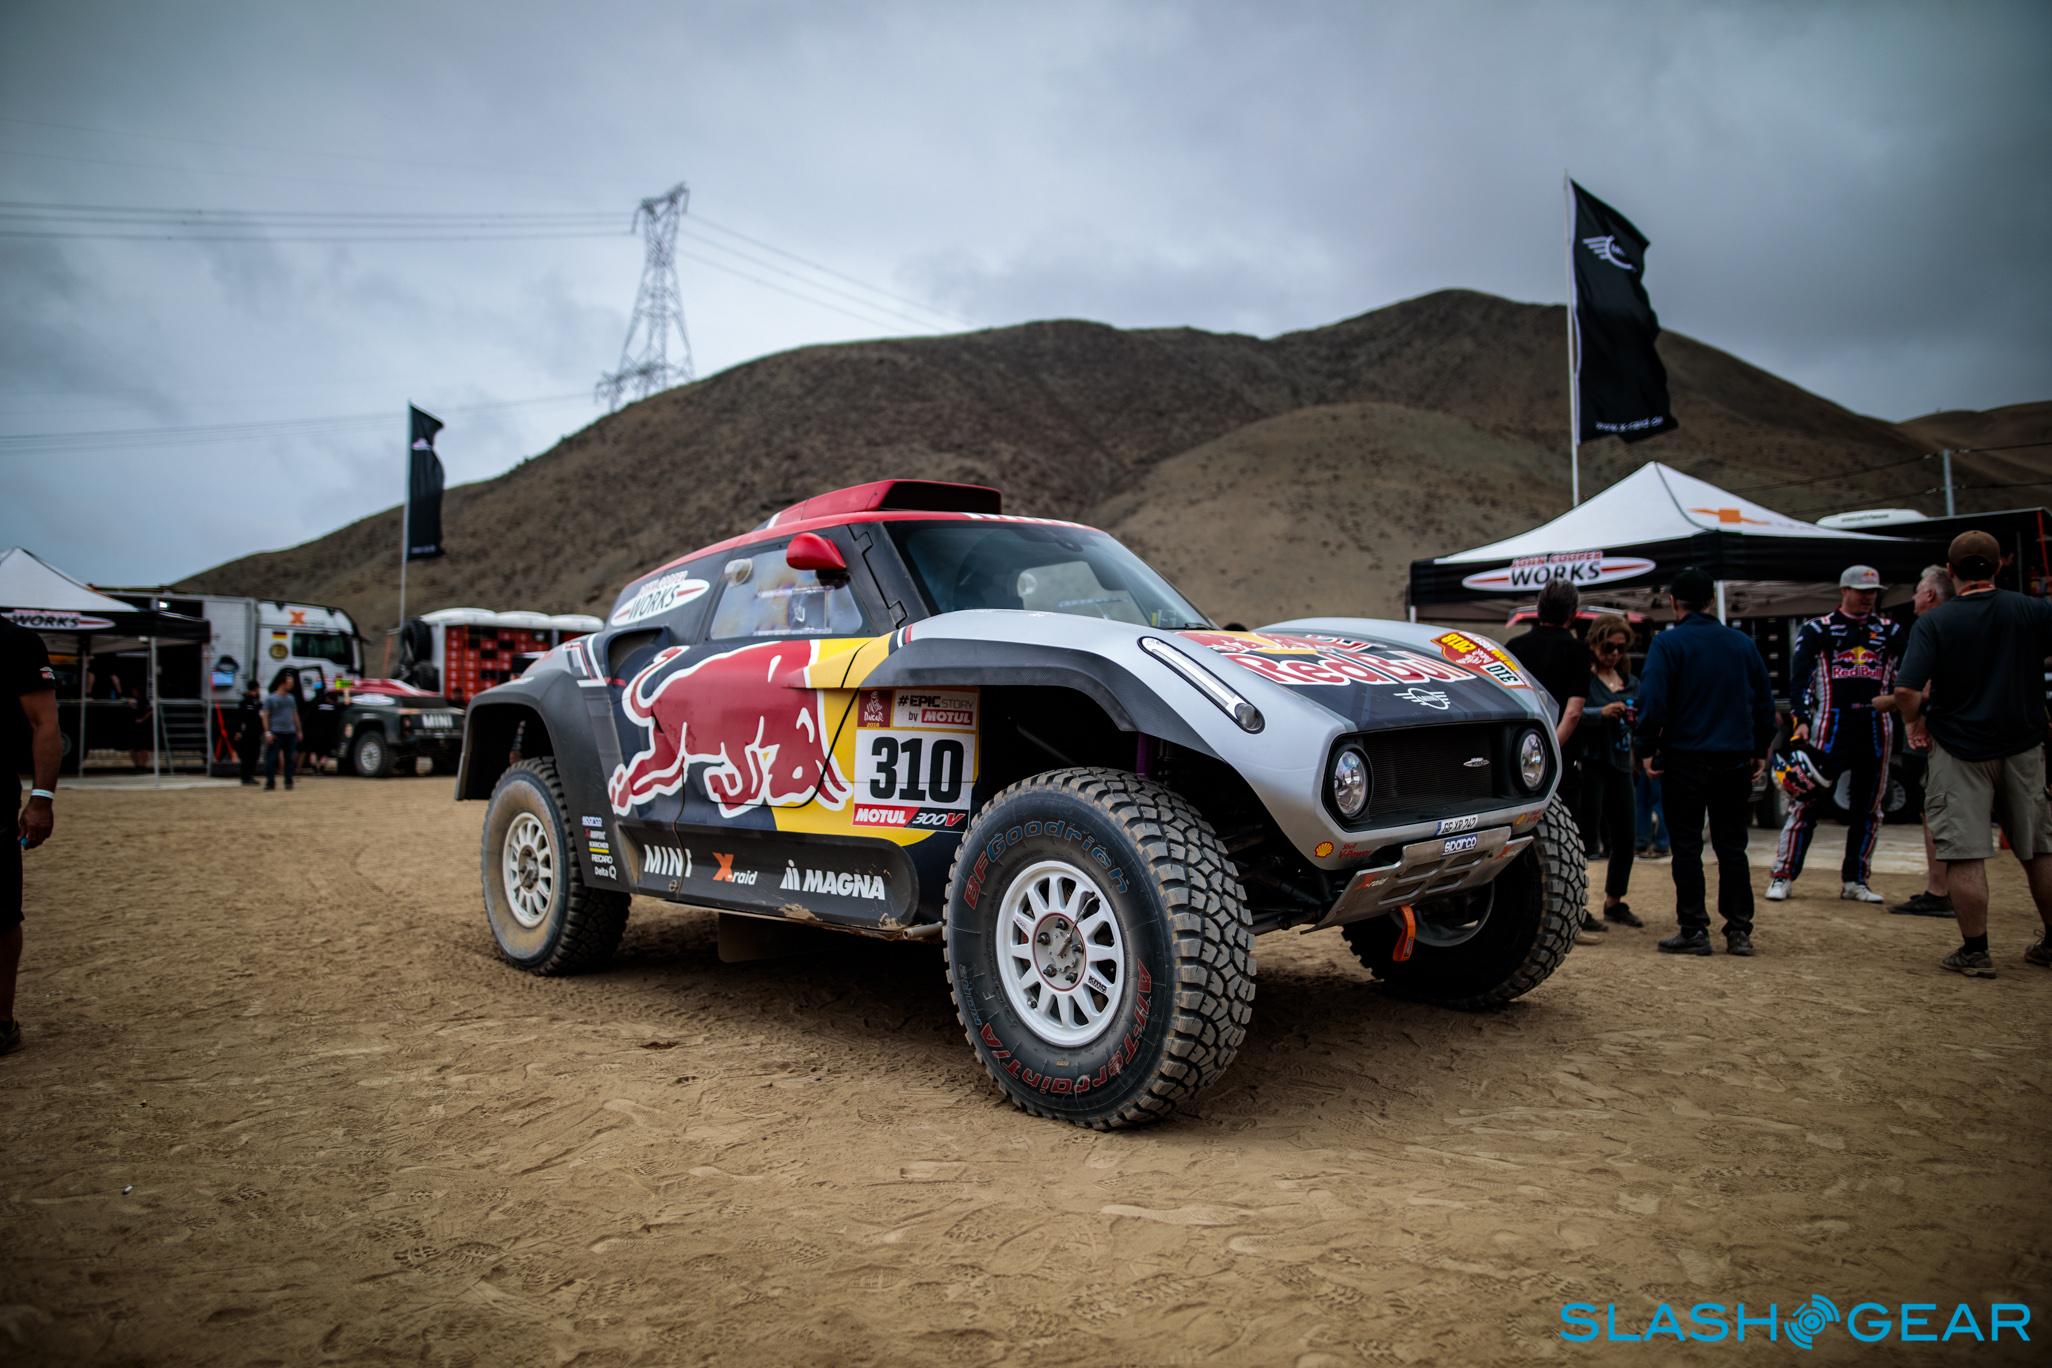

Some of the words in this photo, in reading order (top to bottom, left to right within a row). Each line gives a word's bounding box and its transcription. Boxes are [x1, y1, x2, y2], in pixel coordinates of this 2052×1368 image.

[1512, 556, 1545, 569] JOHN
[1549, 551, 1603, 564] COOPER
[1511, 562, 1601, 586] WORKS
[628, 584, 681, 621] WORKS
[12, 614, 80, 628] WORKS
[1220, 651, 1400, 687] Red
[1338, 650, 1478, 685] Bull
[1486, 664, 1519, 683] 310
[1832, 665, 1860, 679] Red
[1861, 666, 1884, 680] Bull
[421, 713, 454, 729] MINI
[908, 711, 919, 722] by
[923, 711, 972, 724] MOTUL
[870, 736, 965, 804] 310
[854, 807, 908, 825] MOTUL
[911, 811, 967, 828] 300V
[1444, 836, 1477, 853] sparco
[591, 853, 613, 865] RECARO
[643, 844, 693, 879] MINI
[963, 819, 1128, 911] BFGoodrich
[802, 868, 886, 901] MAGNA
[1021, 958, 1152, 1096] All-Terrain
